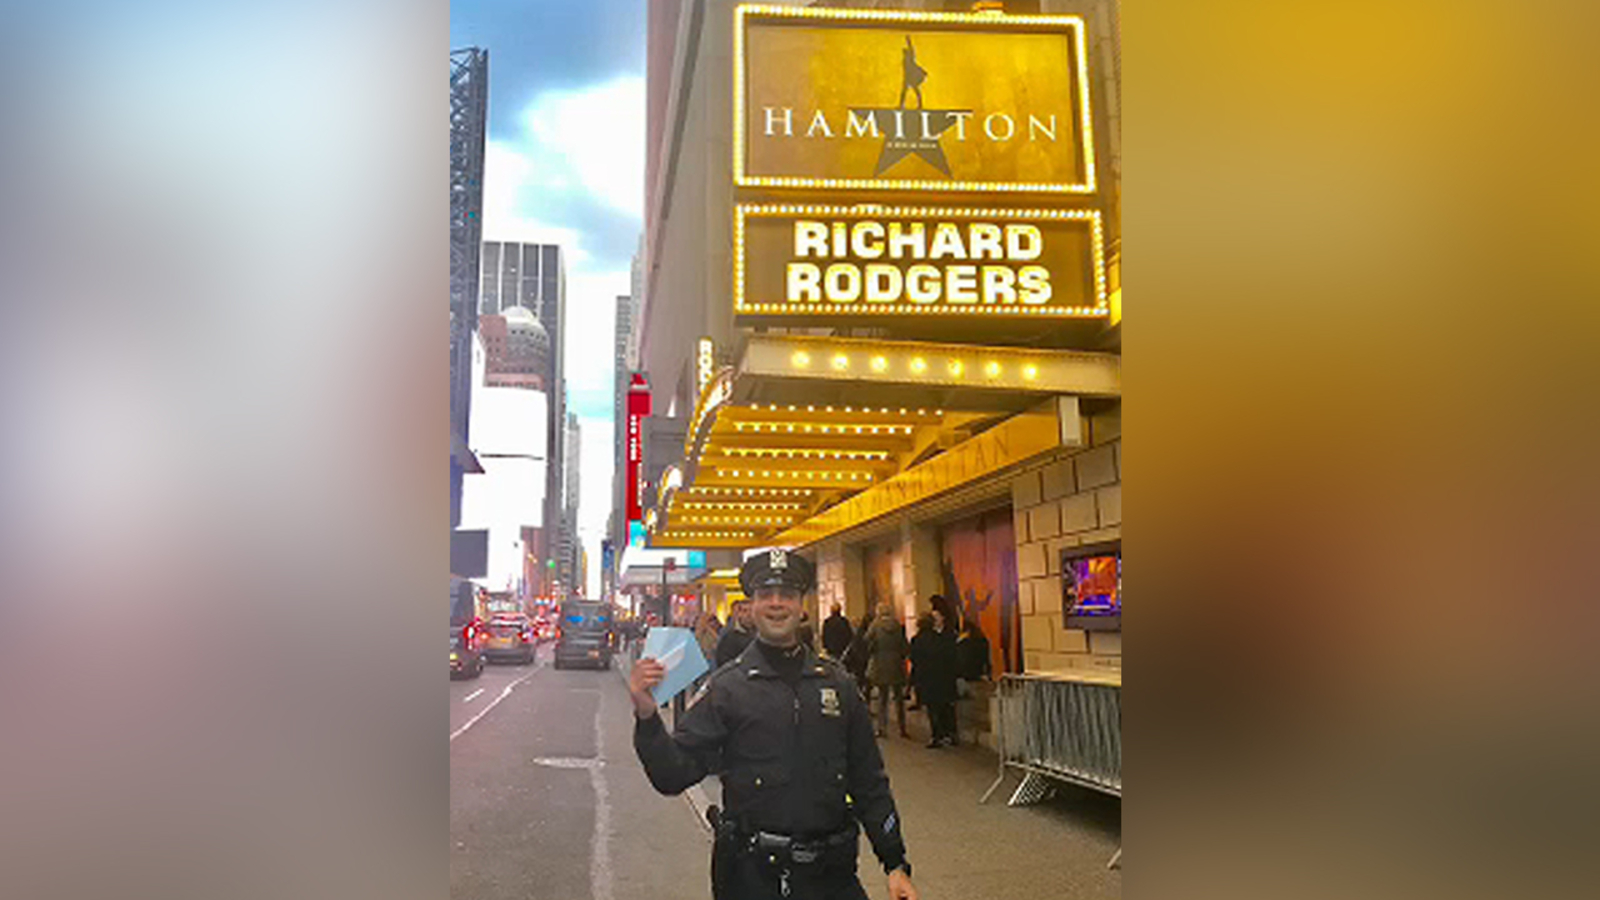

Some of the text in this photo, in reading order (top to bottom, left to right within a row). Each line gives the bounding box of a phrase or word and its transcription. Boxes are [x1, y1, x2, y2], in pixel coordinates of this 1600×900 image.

[762, 105, 1057, 142] HAMILTON
[795, 220, 1043, 259] RICHARD
[786, 263, 1052, 305] RODGERS
